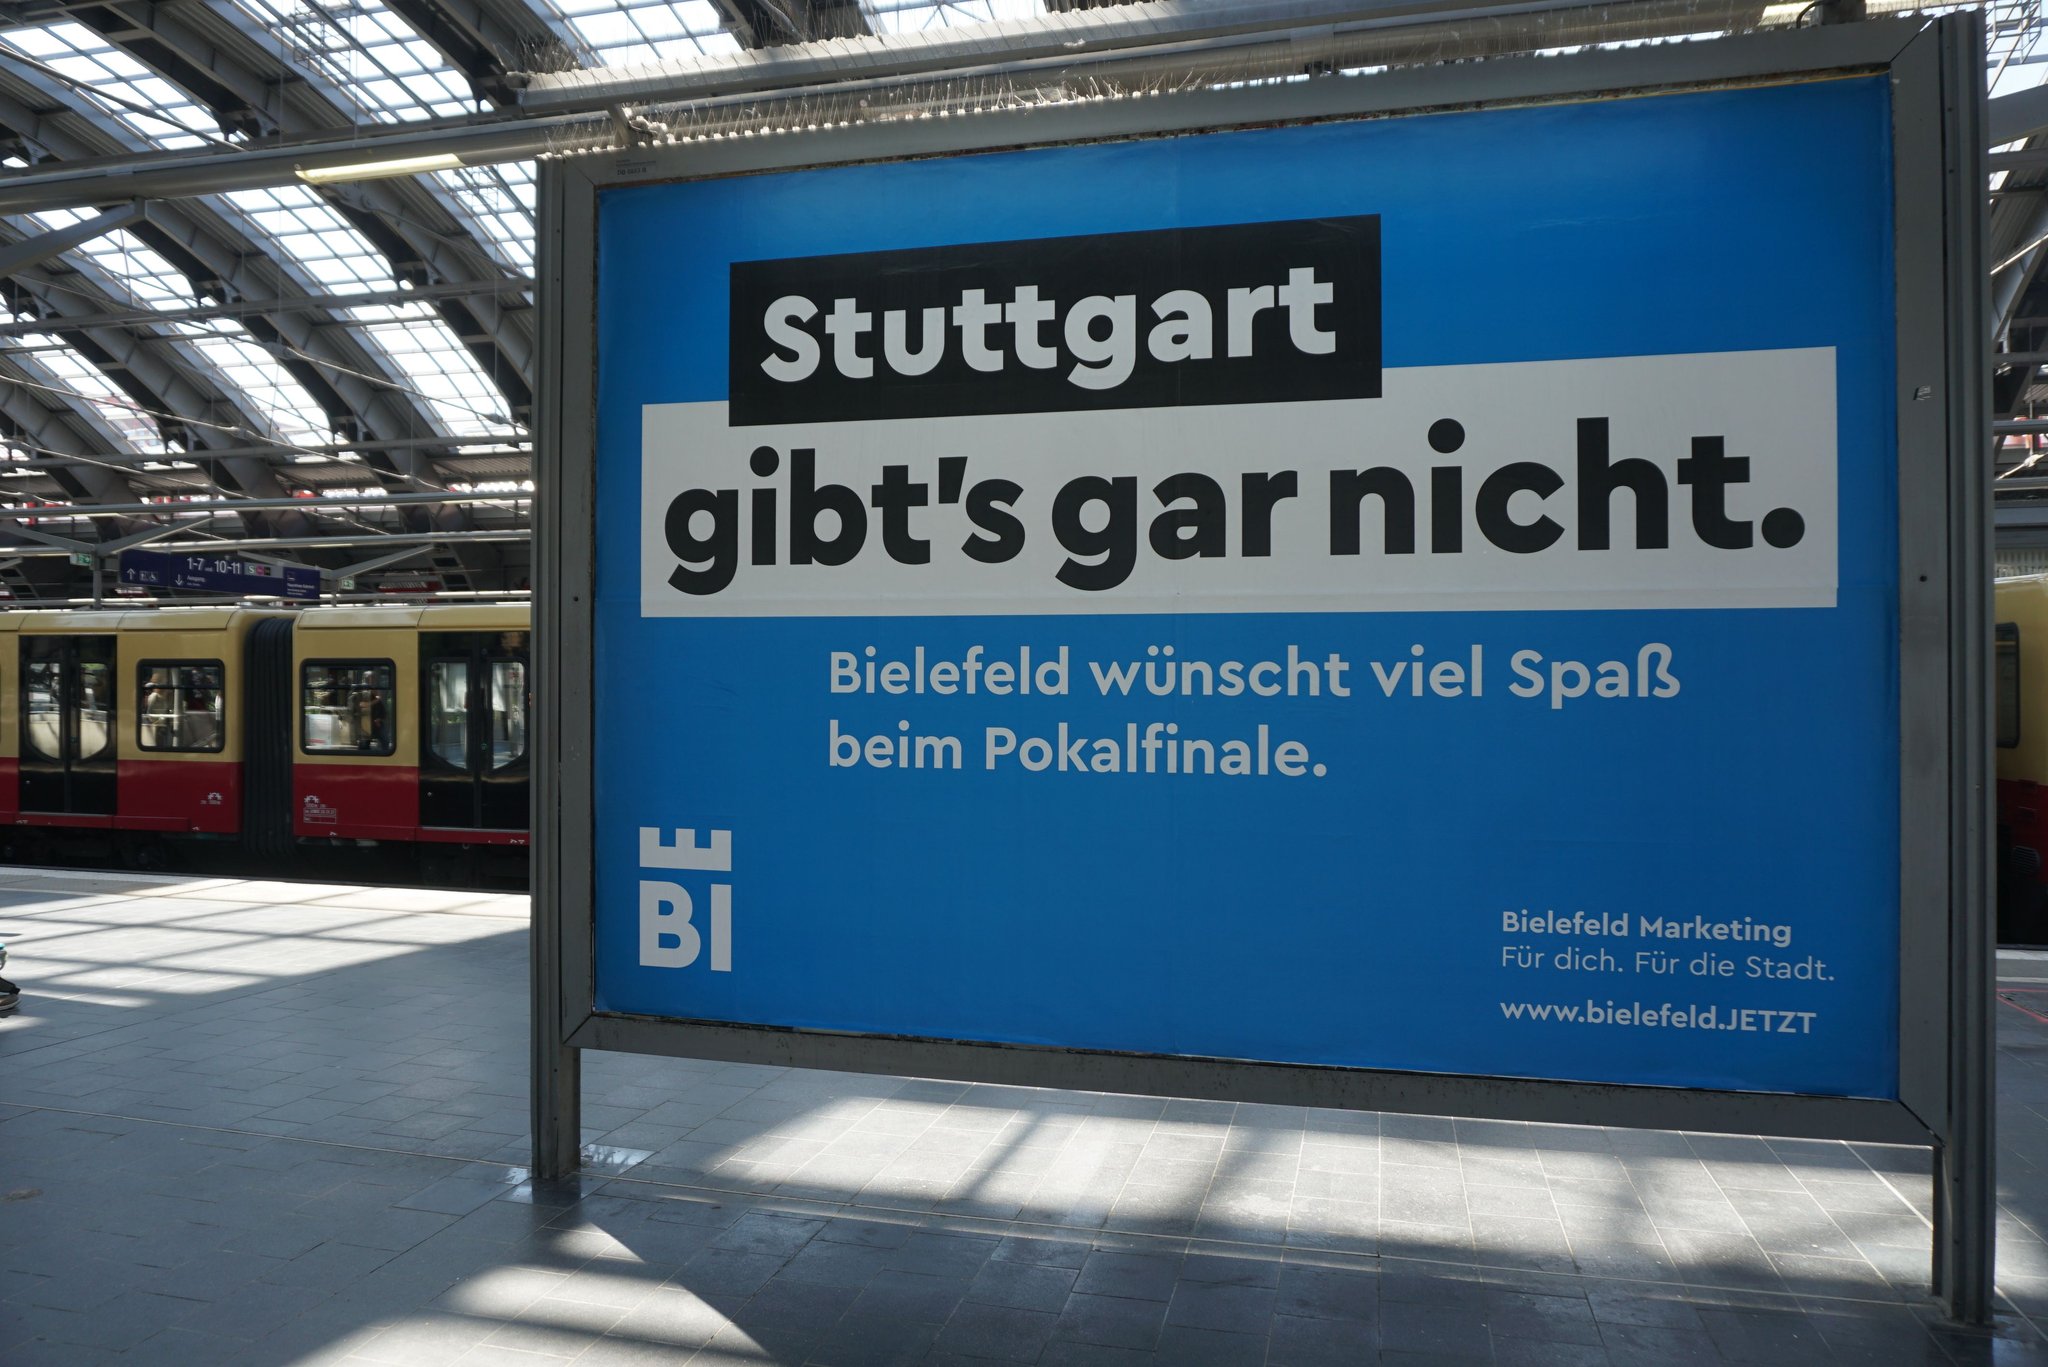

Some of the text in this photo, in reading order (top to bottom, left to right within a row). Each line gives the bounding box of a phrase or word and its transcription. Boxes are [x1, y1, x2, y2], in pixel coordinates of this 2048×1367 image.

[760, 266, 1336, 390] Stuttgart
[664, 417, 1806, 595] gibt's gar nicht.
[186, 557, 205, 571] 1-7
[214, 560, 241, 575] 10-11
[830, 642, 1681, 710] Bielefeld wünscht viel Spaß
[829, 719, 1328, 777] beim Pokalfinale.
[639, 879, 732, 972] BI
[1502, 909, 1792, 948] Bielefeld Marketing
[1502, 945, 1835, 981] Für dich. Für die Stadt.
[1500, 999, 1817, 1034] www.bielefeld.JETZT
